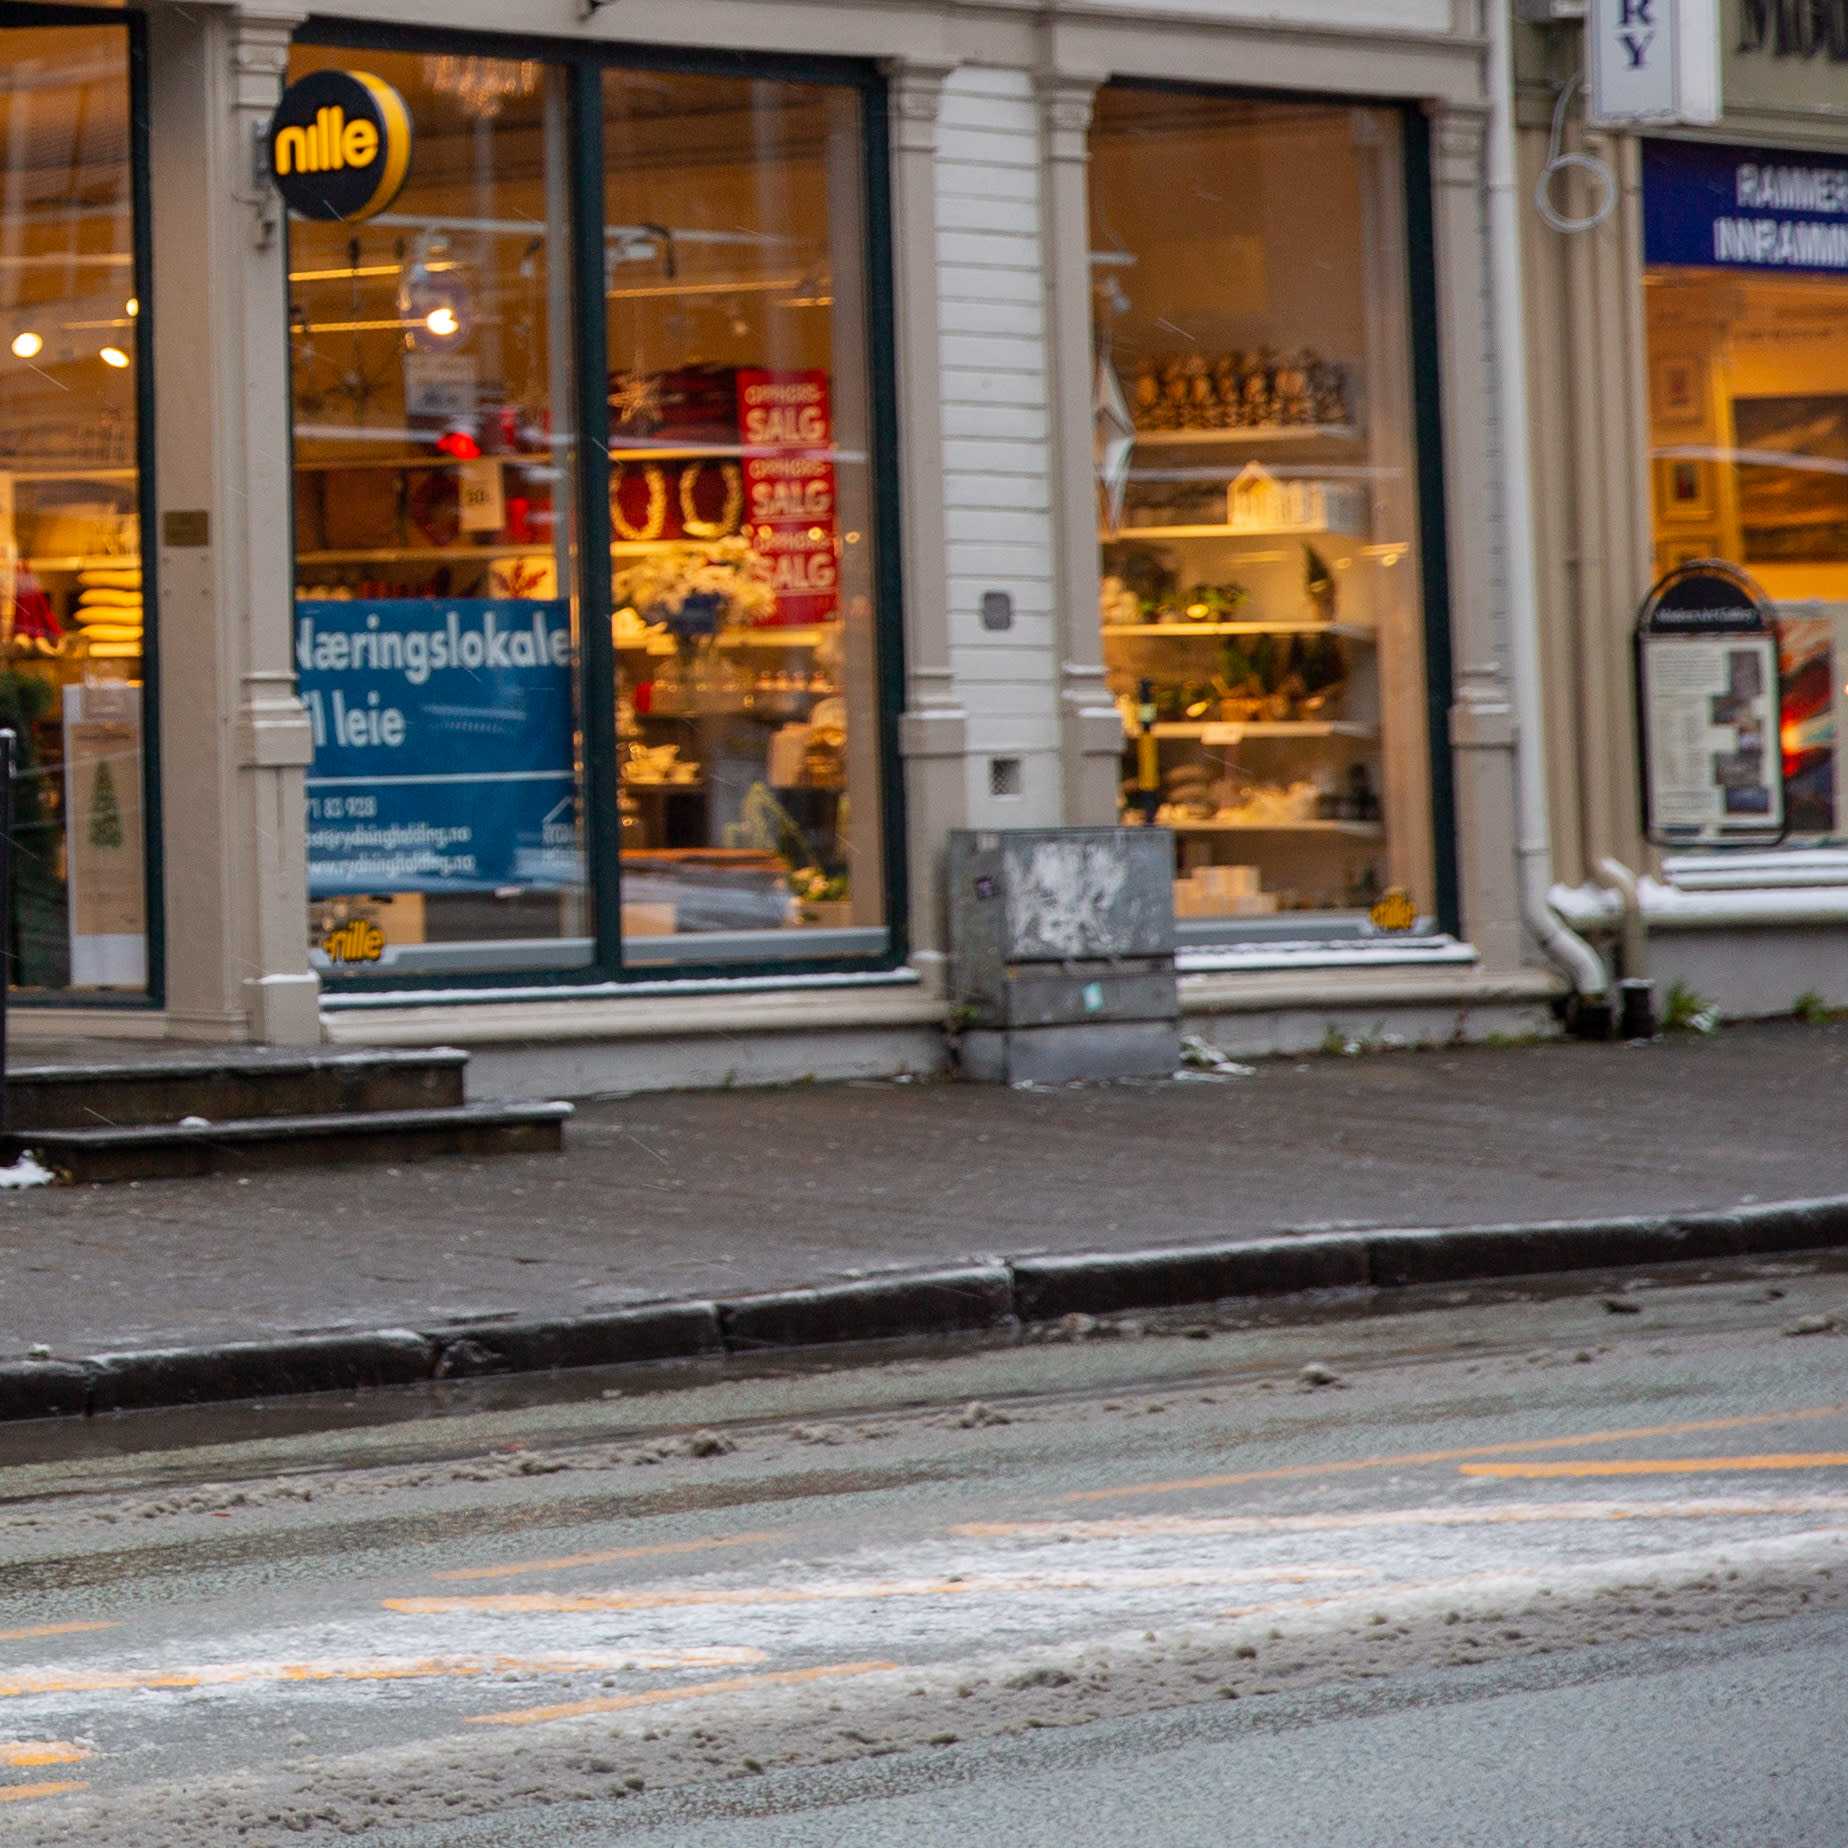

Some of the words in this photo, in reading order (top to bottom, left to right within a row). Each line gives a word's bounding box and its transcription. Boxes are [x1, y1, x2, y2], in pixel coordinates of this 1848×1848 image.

[273, 104, 380, 176] nille
[745, 406, 826, 442] SALG
[751, 479, 832, 516] SALG
[332, 689, 406, 748] leie
